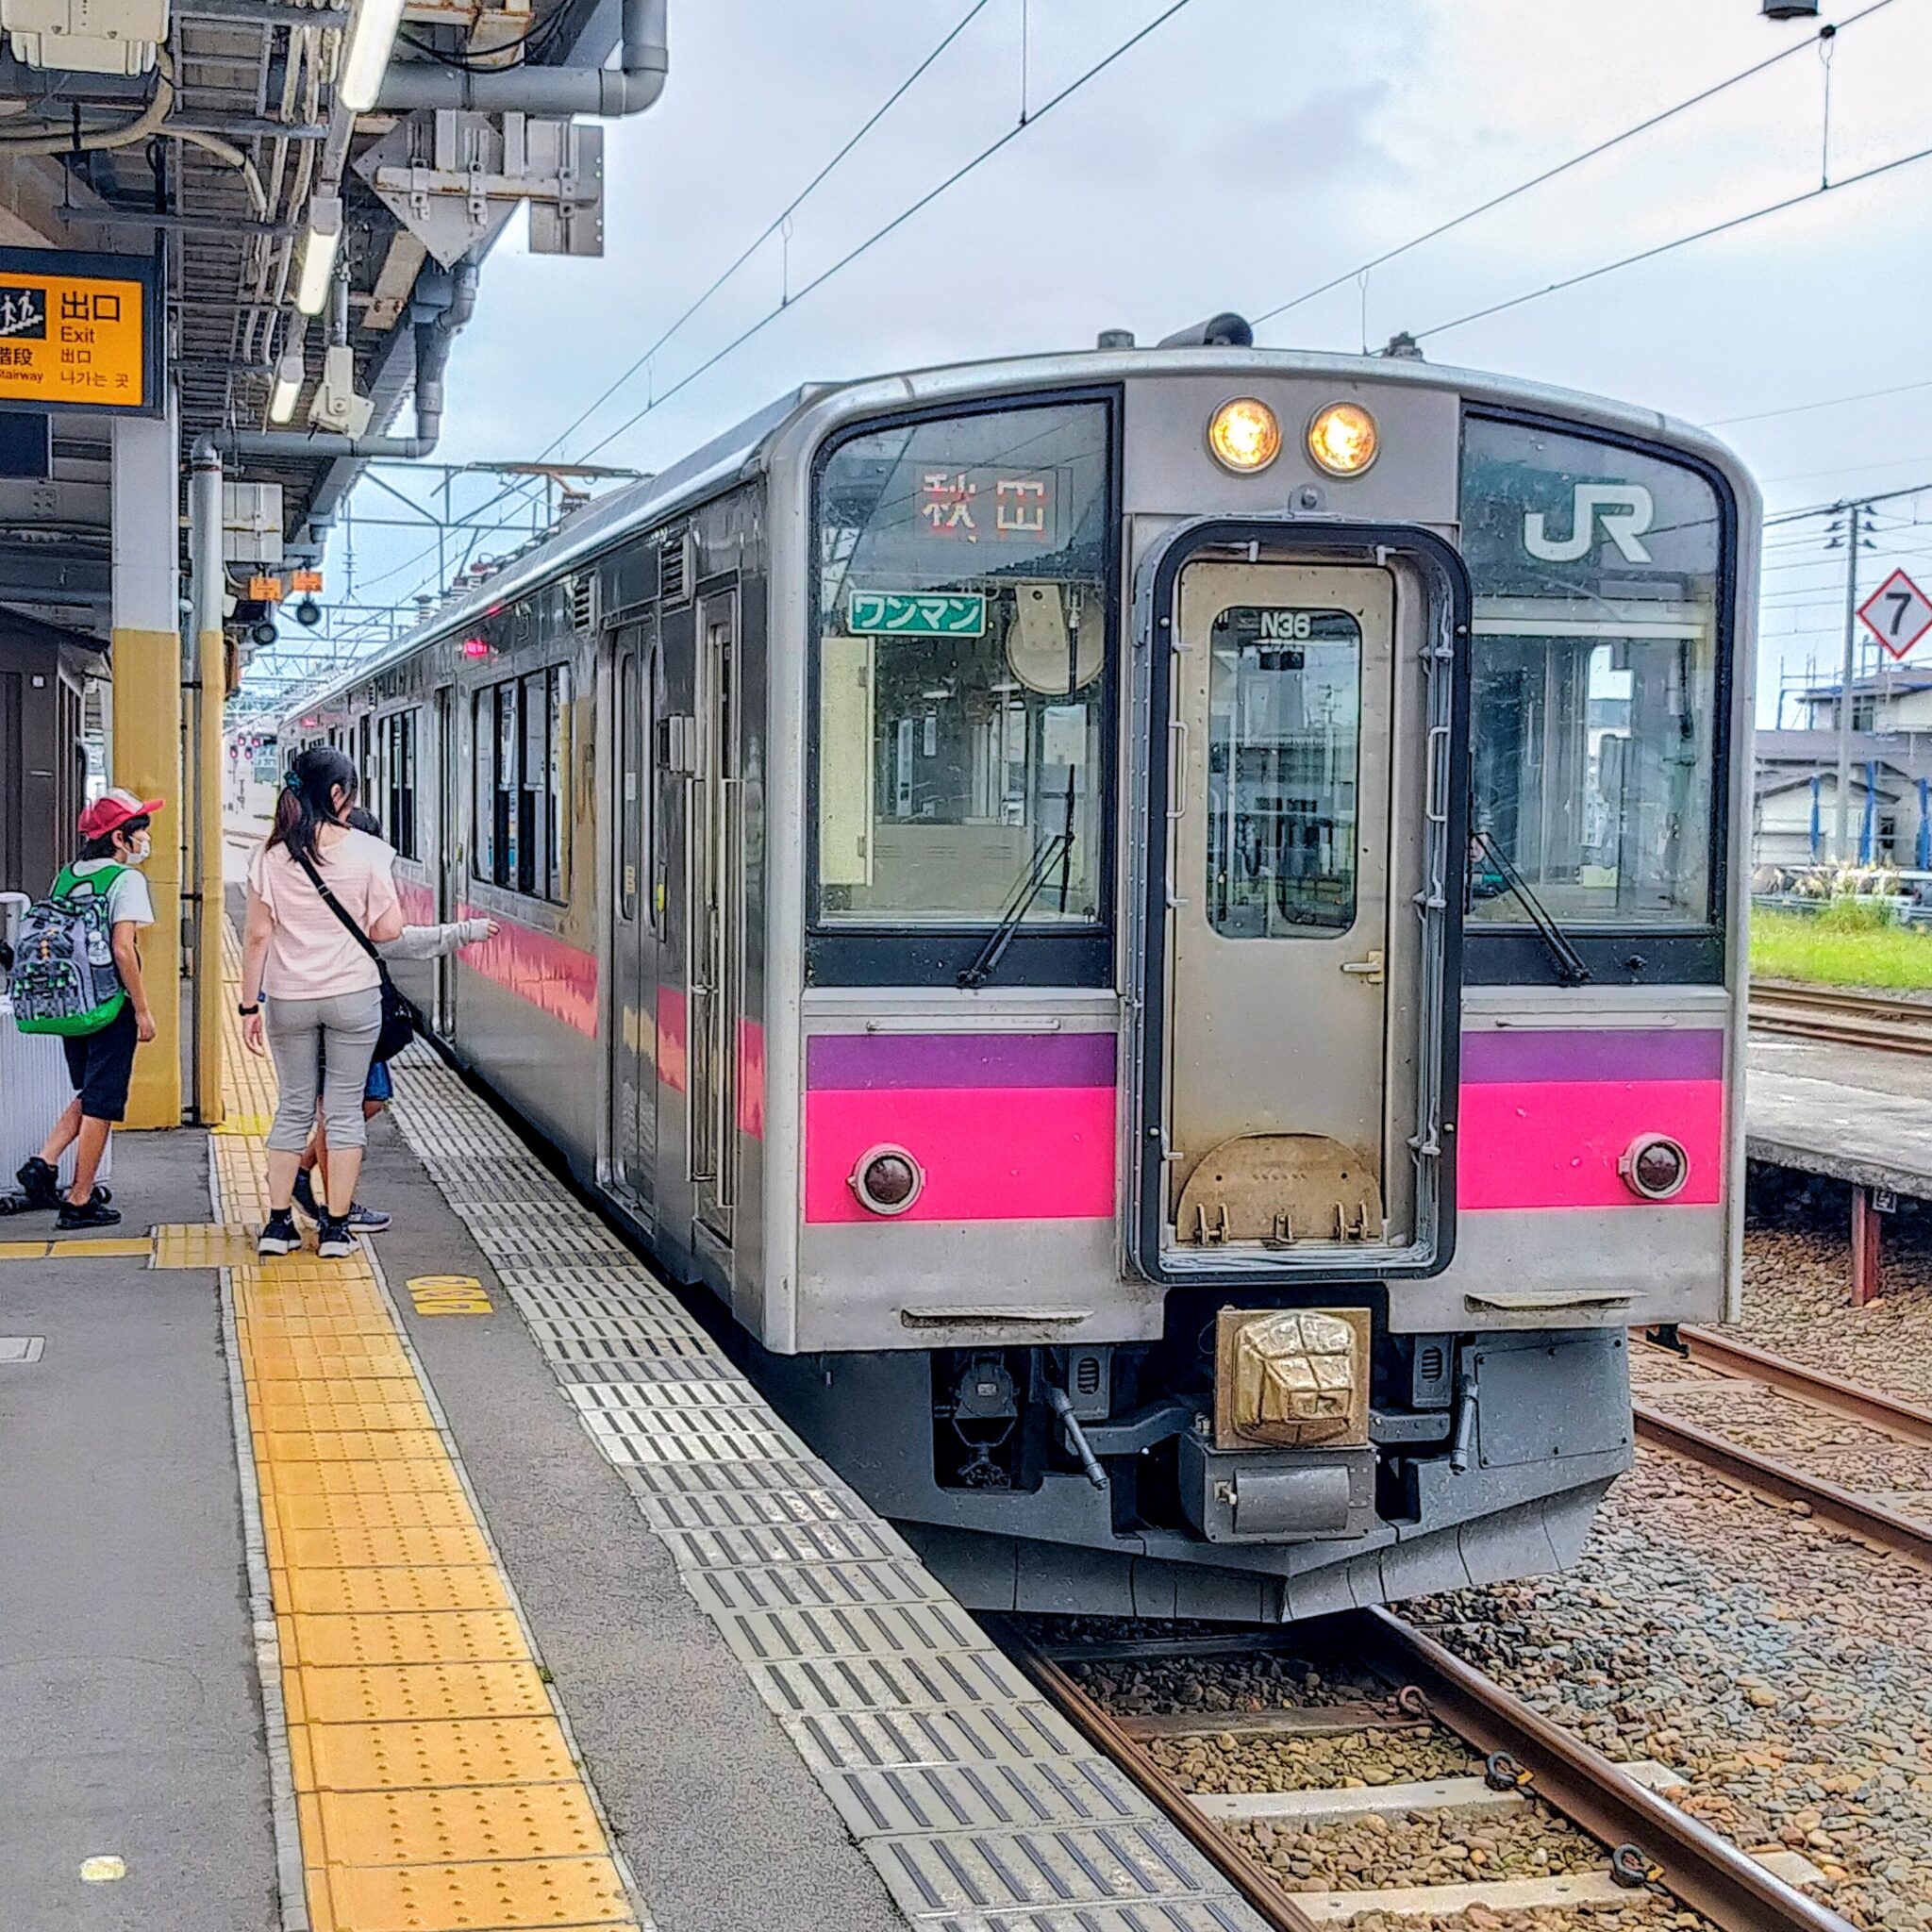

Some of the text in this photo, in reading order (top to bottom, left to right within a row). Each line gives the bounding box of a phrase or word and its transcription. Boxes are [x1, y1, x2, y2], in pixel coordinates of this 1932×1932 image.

[61, 291, 120, 322] 出口
[60, 325, 95, 342] Exit
[61, 348, 92, 364] 出口
[60, 371, 128, 388] 나가는 곳
[1524, 484, 1654, 563] JR
[855, 596, 980, 630] ワンマン
[1260, 611, 1311, 639] N36
[1885, 592, 1911, 636] 7
